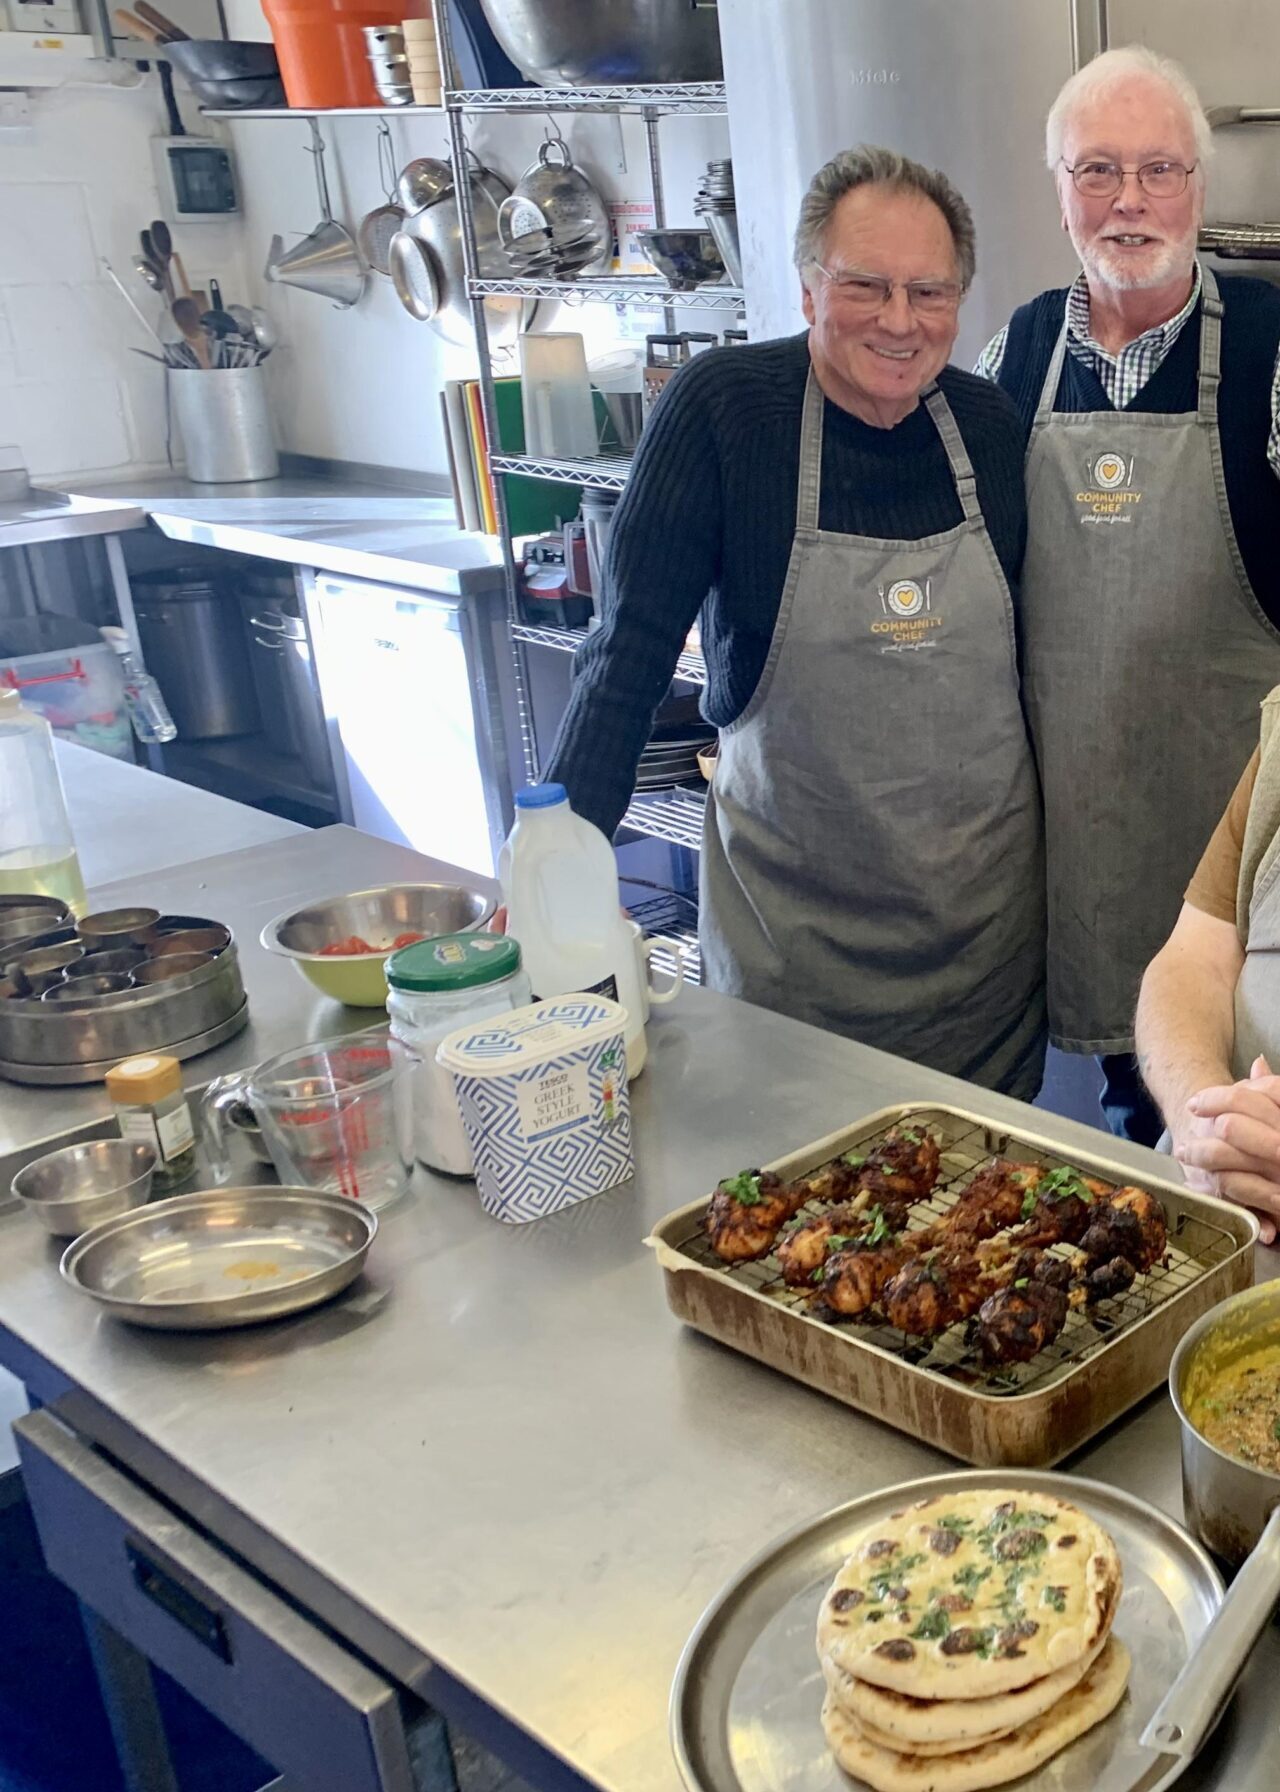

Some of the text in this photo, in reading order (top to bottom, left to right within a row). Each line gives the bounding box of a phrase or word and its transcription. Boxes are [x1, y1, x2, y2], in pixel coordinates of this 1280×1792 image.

[1075, 492, 1142, 503] COMMUNITY
[1092, 503, 1122, 513] CHEF
[870, 617, 943, 633] COMMUNITY
[893, 631, 925, 642] CHEF
[539, 1073, 569, 1090] TESCO
[534, 1083, 575, 1104] GREEK
[537, 1095, 574, 1115] STYLE
[533, 1104, 581, 1128] YOGURT
